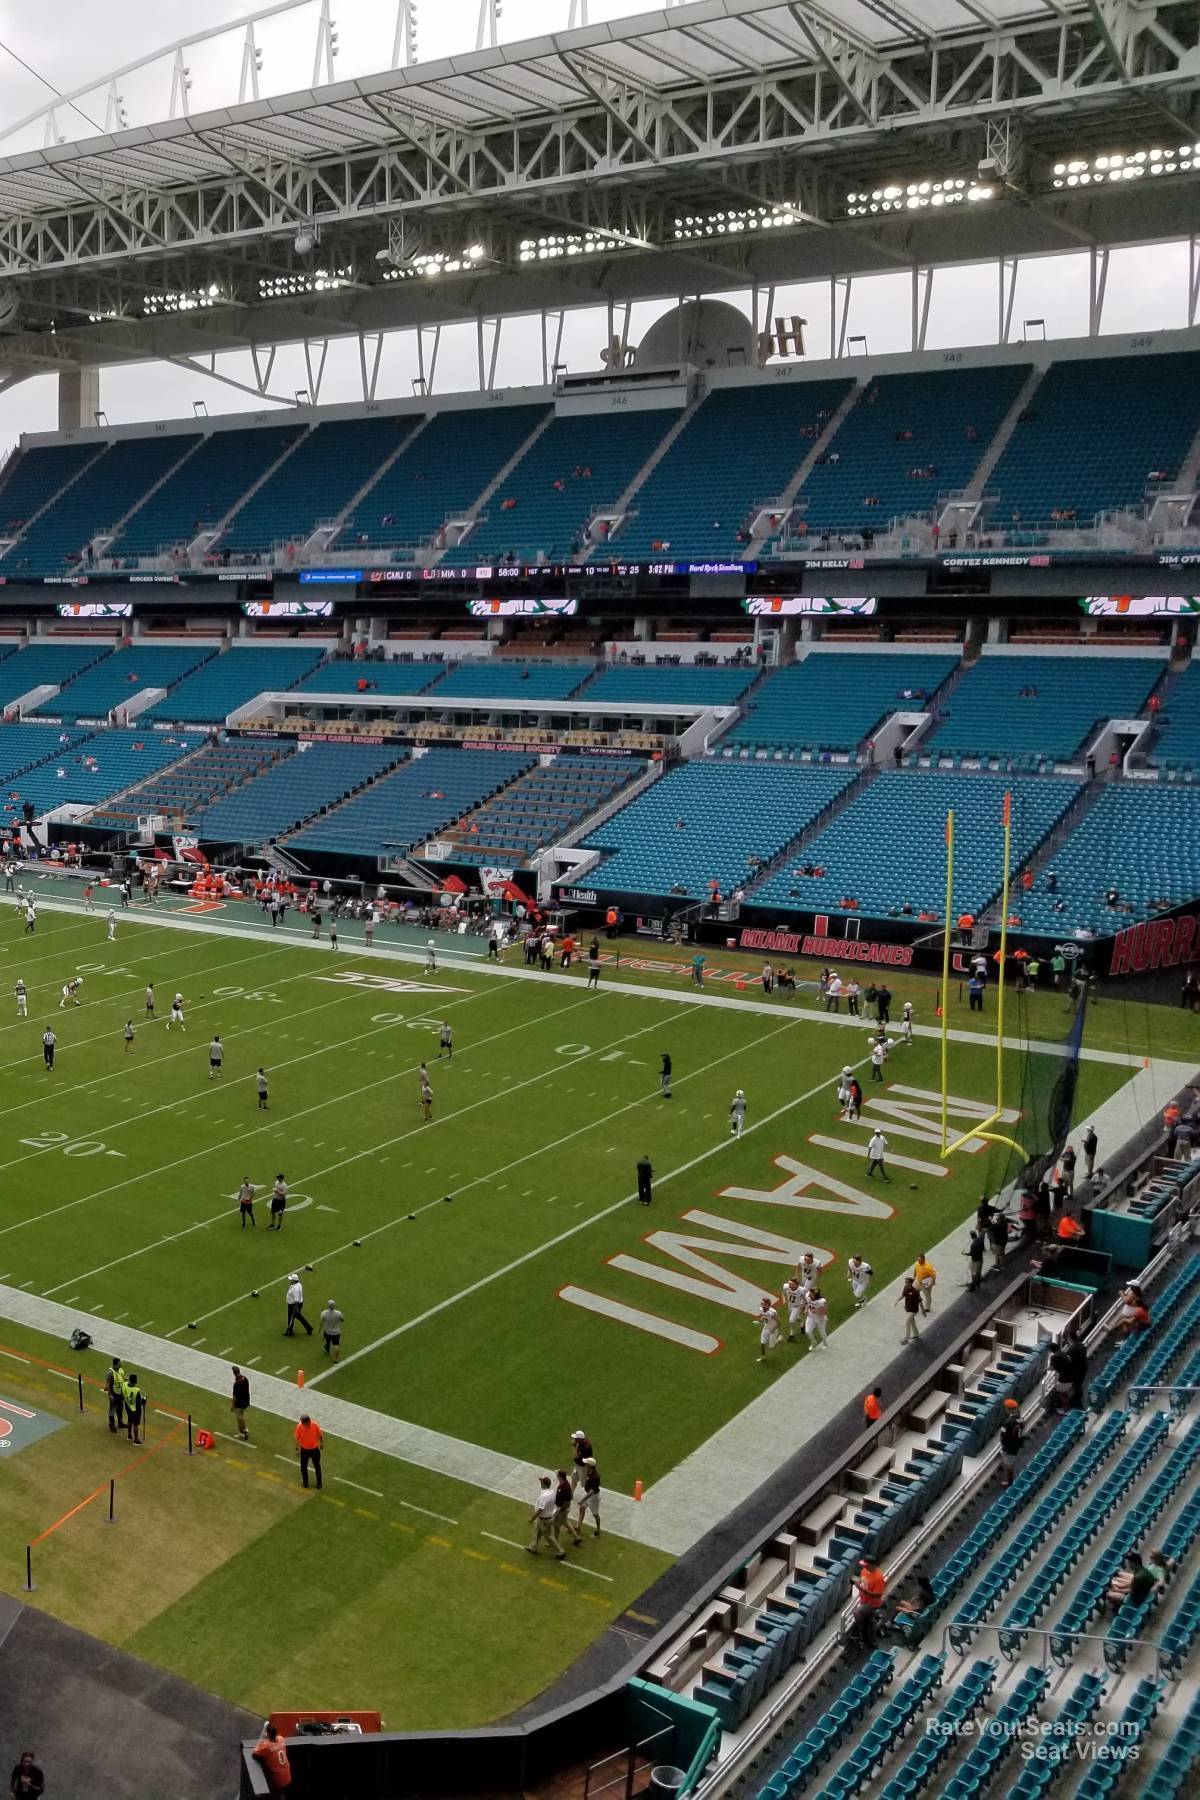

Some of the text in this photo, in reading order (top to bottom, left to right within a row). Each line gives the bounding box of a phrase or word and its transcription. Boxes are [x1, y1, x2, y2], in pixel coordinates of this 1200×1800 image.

[822, 559, 849, 568] KELLY
[943, 558, 981, 566] CORTEZ
[982, 557, 1029, 566] KENNEDY
[1159, 555, 1178, 564] JIM
[441, 569, 467, 578] MIA 0
[585, 567, 595, 575] 10
[629, 566, 640, 574] 25
[664, 564, 674, 574] PM
[386, 571, 404, 579] CMU
[740, 928, 914, 966] MIAMI HURRICANES
[1109, 914, 1200, 975] HURR
[18, 1131, 106, 1157] 20
[557, 1083, 1026, 1357] MIAMI
